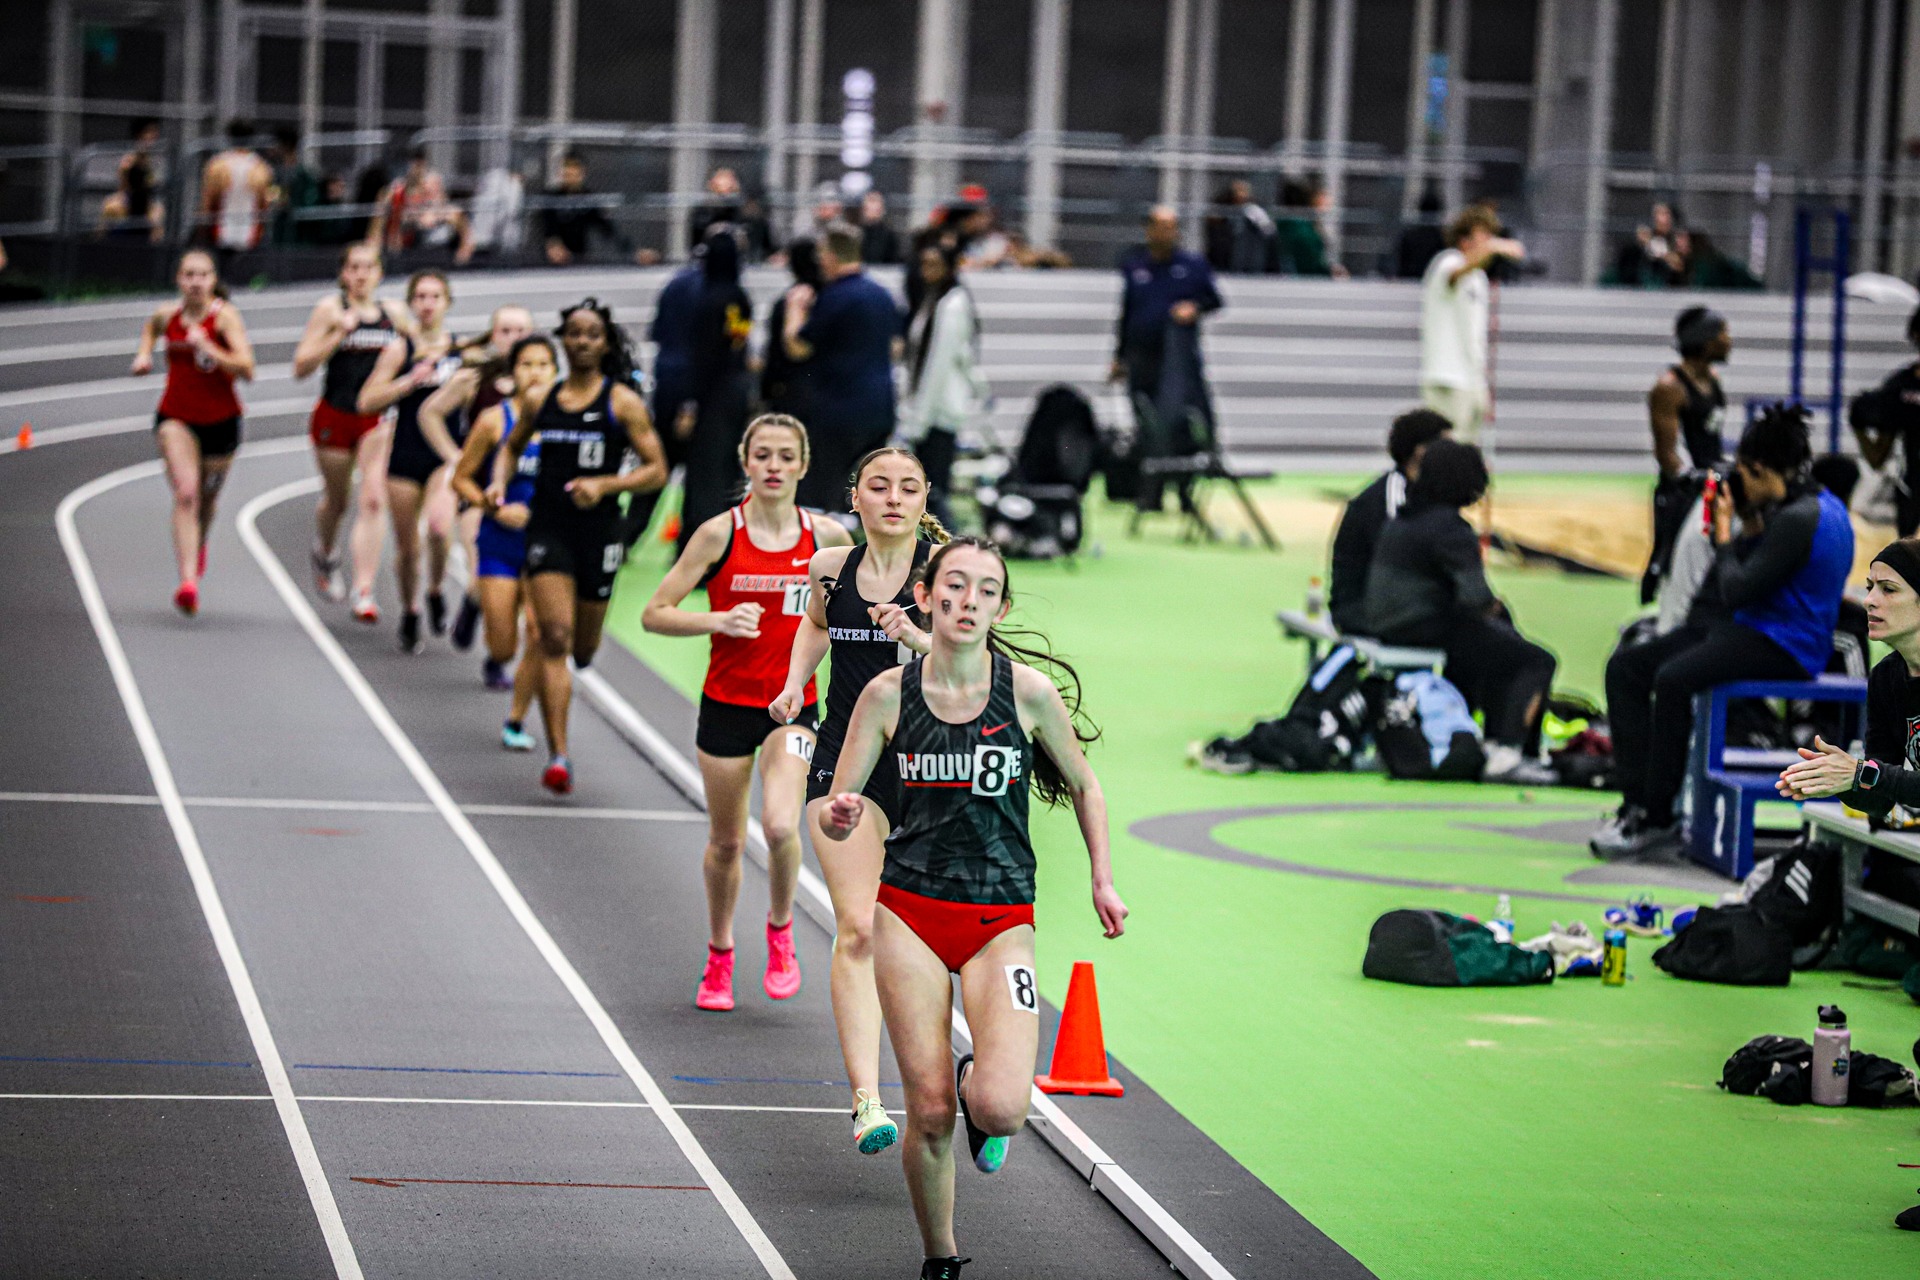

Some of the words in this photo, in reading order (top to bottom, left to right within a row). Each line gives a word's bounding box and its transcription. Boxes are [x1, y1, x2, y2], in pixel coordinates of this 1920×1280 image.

[796, 736, 812, 762] 10
[978, 749, 1006, 793] 8
[1013, 968, 1035, 1009] 8
